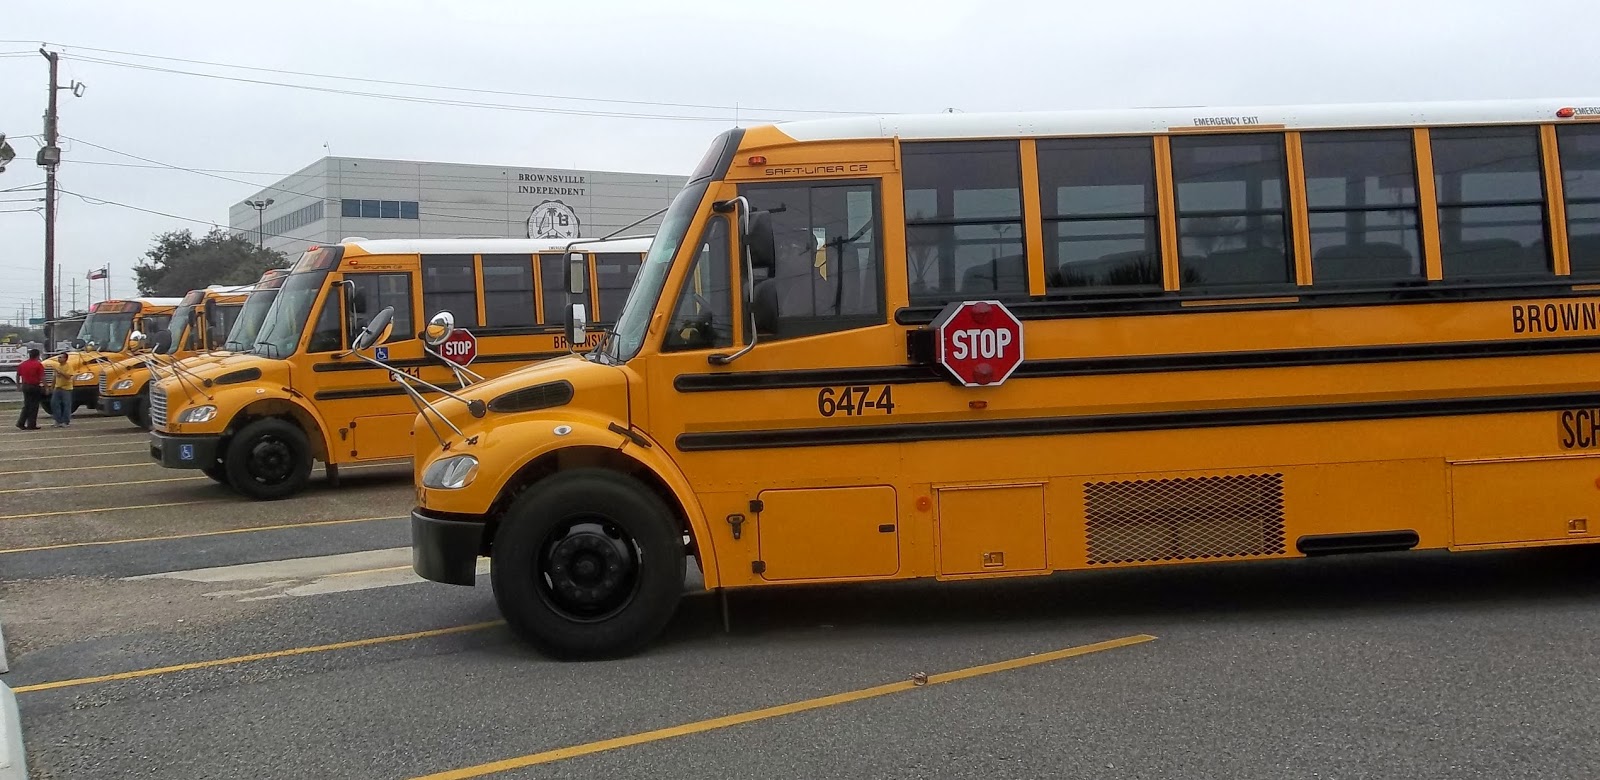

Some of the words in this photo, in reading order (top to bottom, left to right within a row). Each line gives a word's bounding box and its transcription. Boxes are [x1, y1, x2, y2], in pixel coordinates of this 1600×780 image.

[1574, 107, 1600, 115] EMERG
[1194, 117, 1240, 126] EMERGENCY
[1242, 116, 1259, 125] EXIT
[849, 164, 868, 172] C2
[518, 173, 586, 184] BROWNSVILLE
[518, 185, 586, 196] INDEPENDENT
[1512, 302, 1600, 334] BROWN
[445, 340, 472, 356] STOP
[952, 328, 1012, 360] STOP
[817, 385, 894, 417] 647-4
